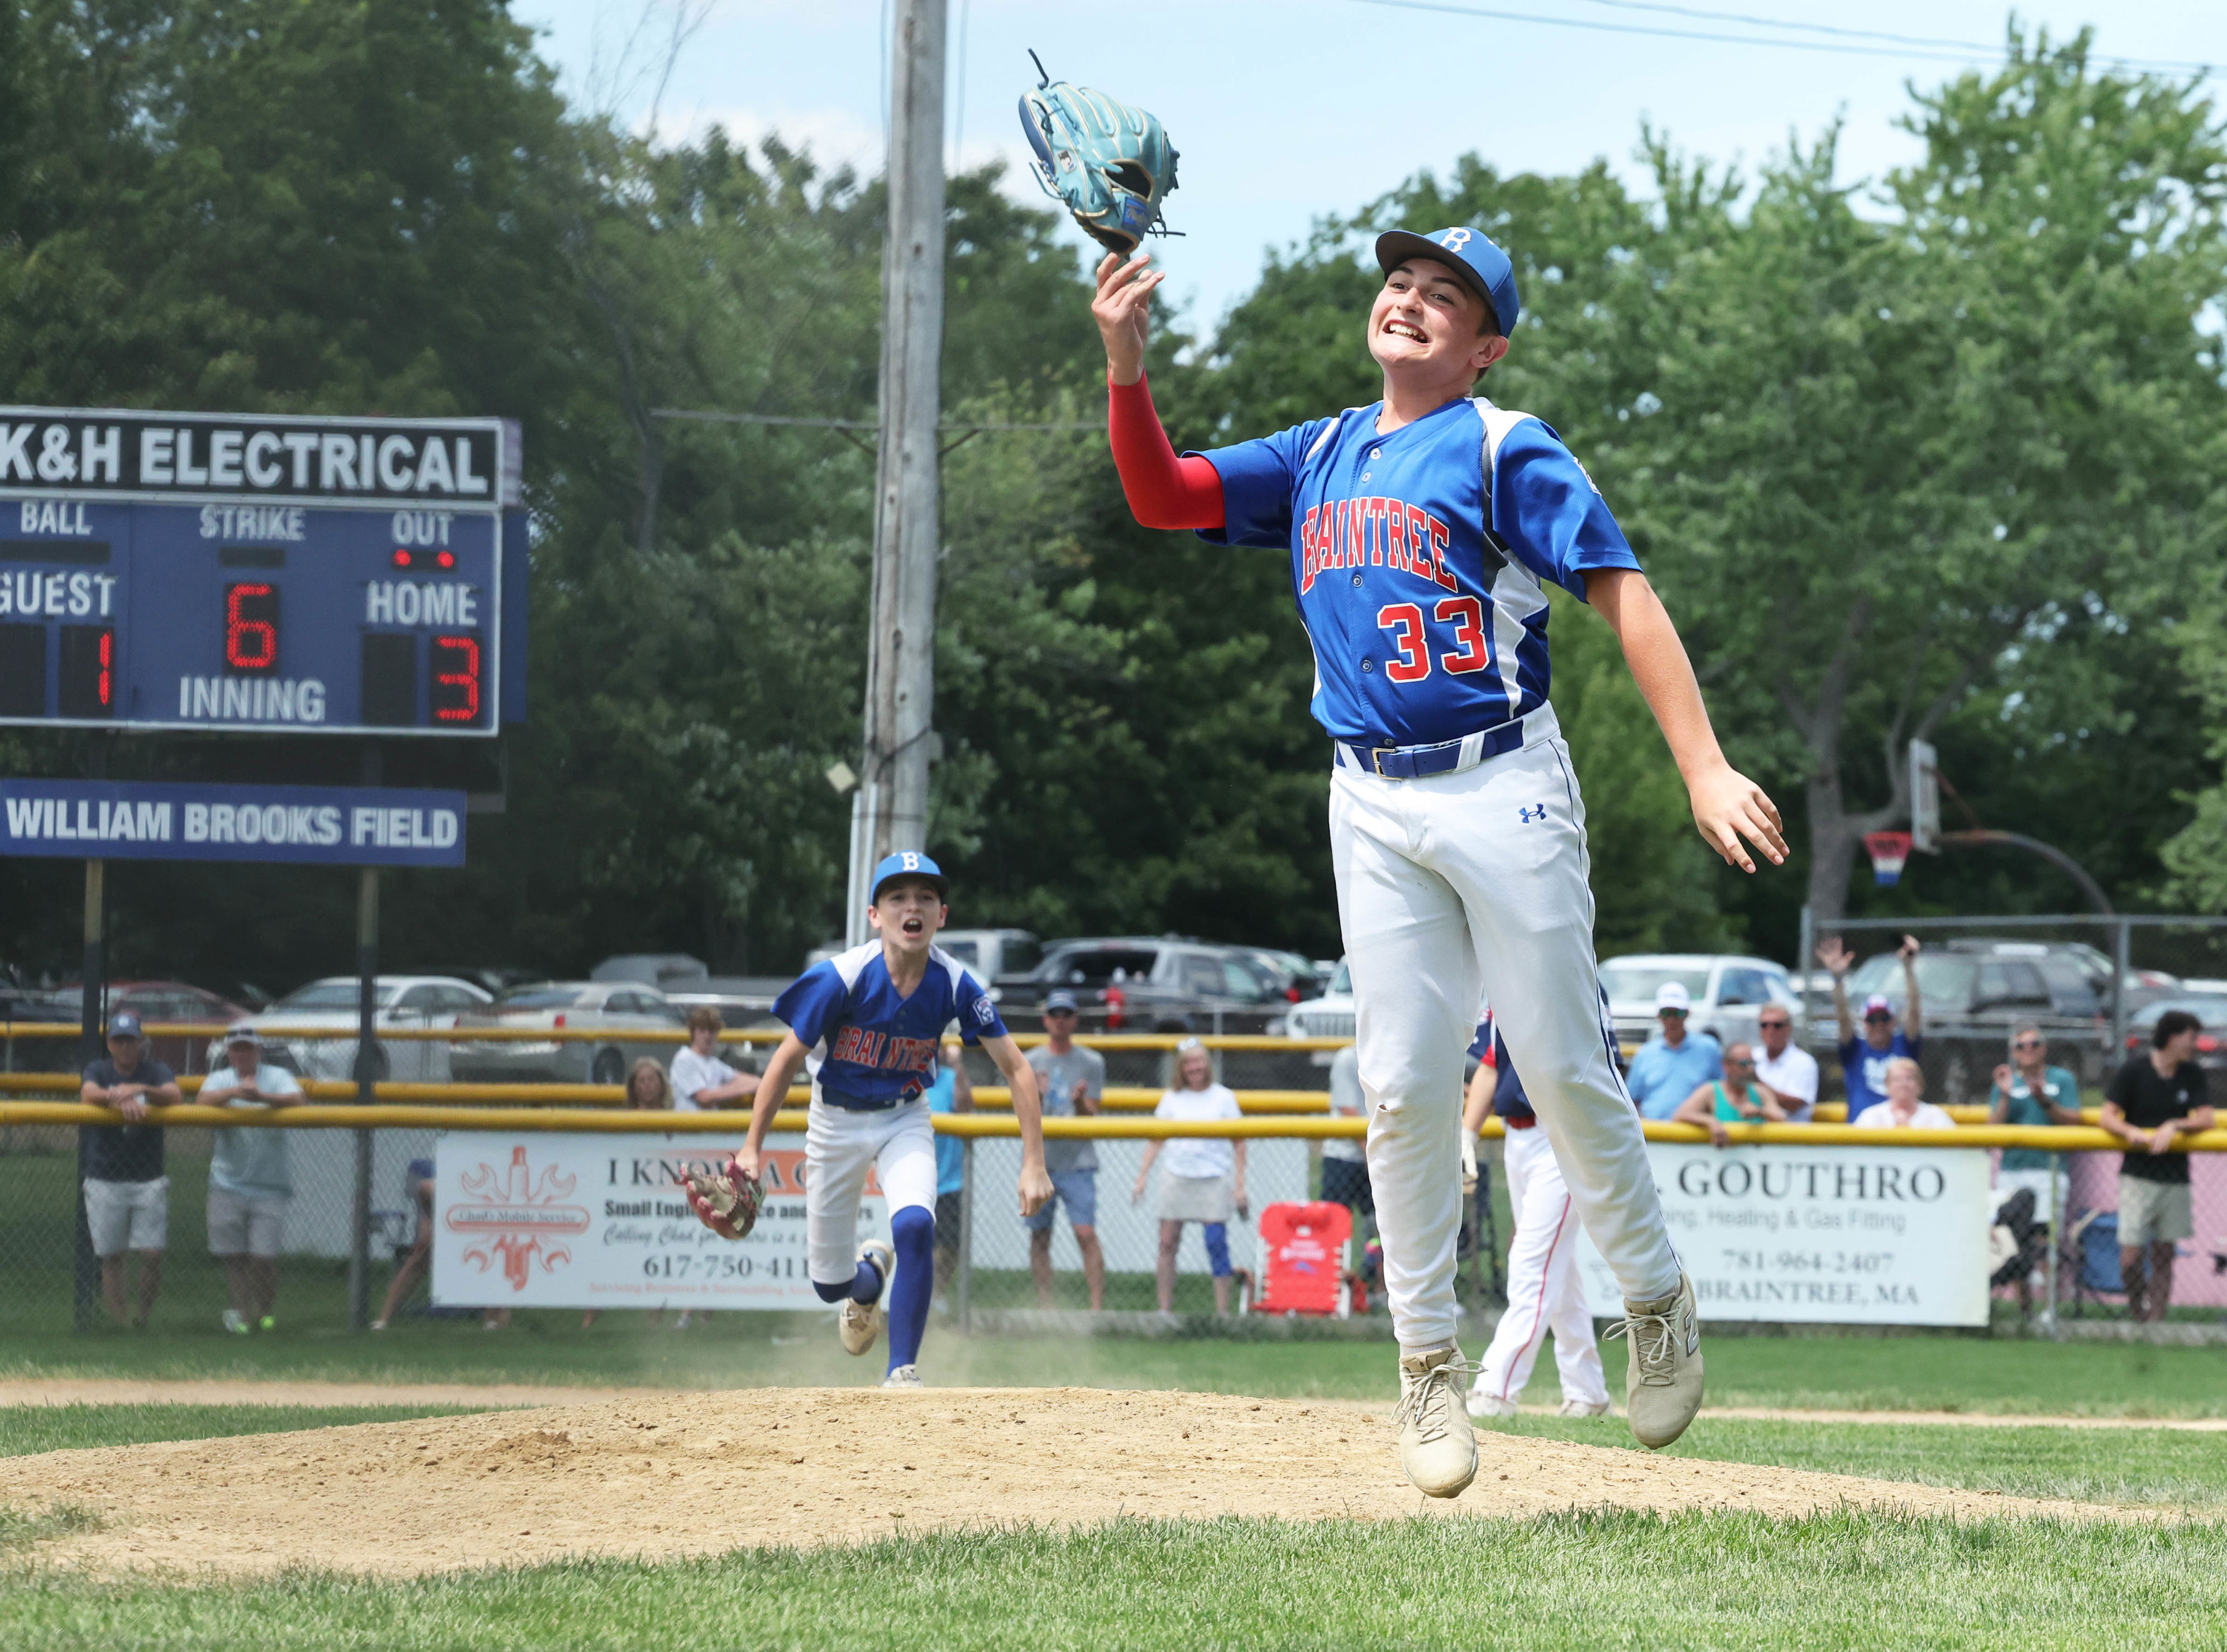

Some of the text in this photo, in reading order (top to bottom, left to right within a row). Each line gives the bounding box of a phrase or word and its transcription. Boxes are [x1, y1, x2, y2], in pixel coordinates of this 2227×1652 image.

[1440, 227, 1471, 253] B
[0, 423, 488, 494] K&H ELECTRICAL
[21, 499, 93, 536] BALL
[199, 505, 306, 541] STRIKE
[392, 510, 454, 545] OUT
[1301, 496, 1458, 594] BRAINTREE
[366, 581, 478, 626] HOME
[227, 583, 276, 668] 6
[1377, 596, 1490, 683] 33
[99, 631, 111, 705] 1
[434, 635, 479, 720] 3
[179, 676, 326, 722] INNING
[6, 797, 458, 848] WILLIAM BROOKS FIELD
[901, 851, 920, 871] B
[609, 1158, 618, 1185] I
[1679, 1158, 1946, 1203] GOUTHRO
[605, 1199, 652, 1218] Small
[1707, 1206, 1780, 1232] Heating
[1786, 1206, 1799, 1228] &
[1803, 1208, 1842, 1229] Gas
[1848, 1208, 1906, 1236] Fitting
[643, 1254, 810, 1279] 617-750-411
[1722, 1248, 1895, 1275] 781-964-2407
[1875, 1284, 1919, 1306] MA
